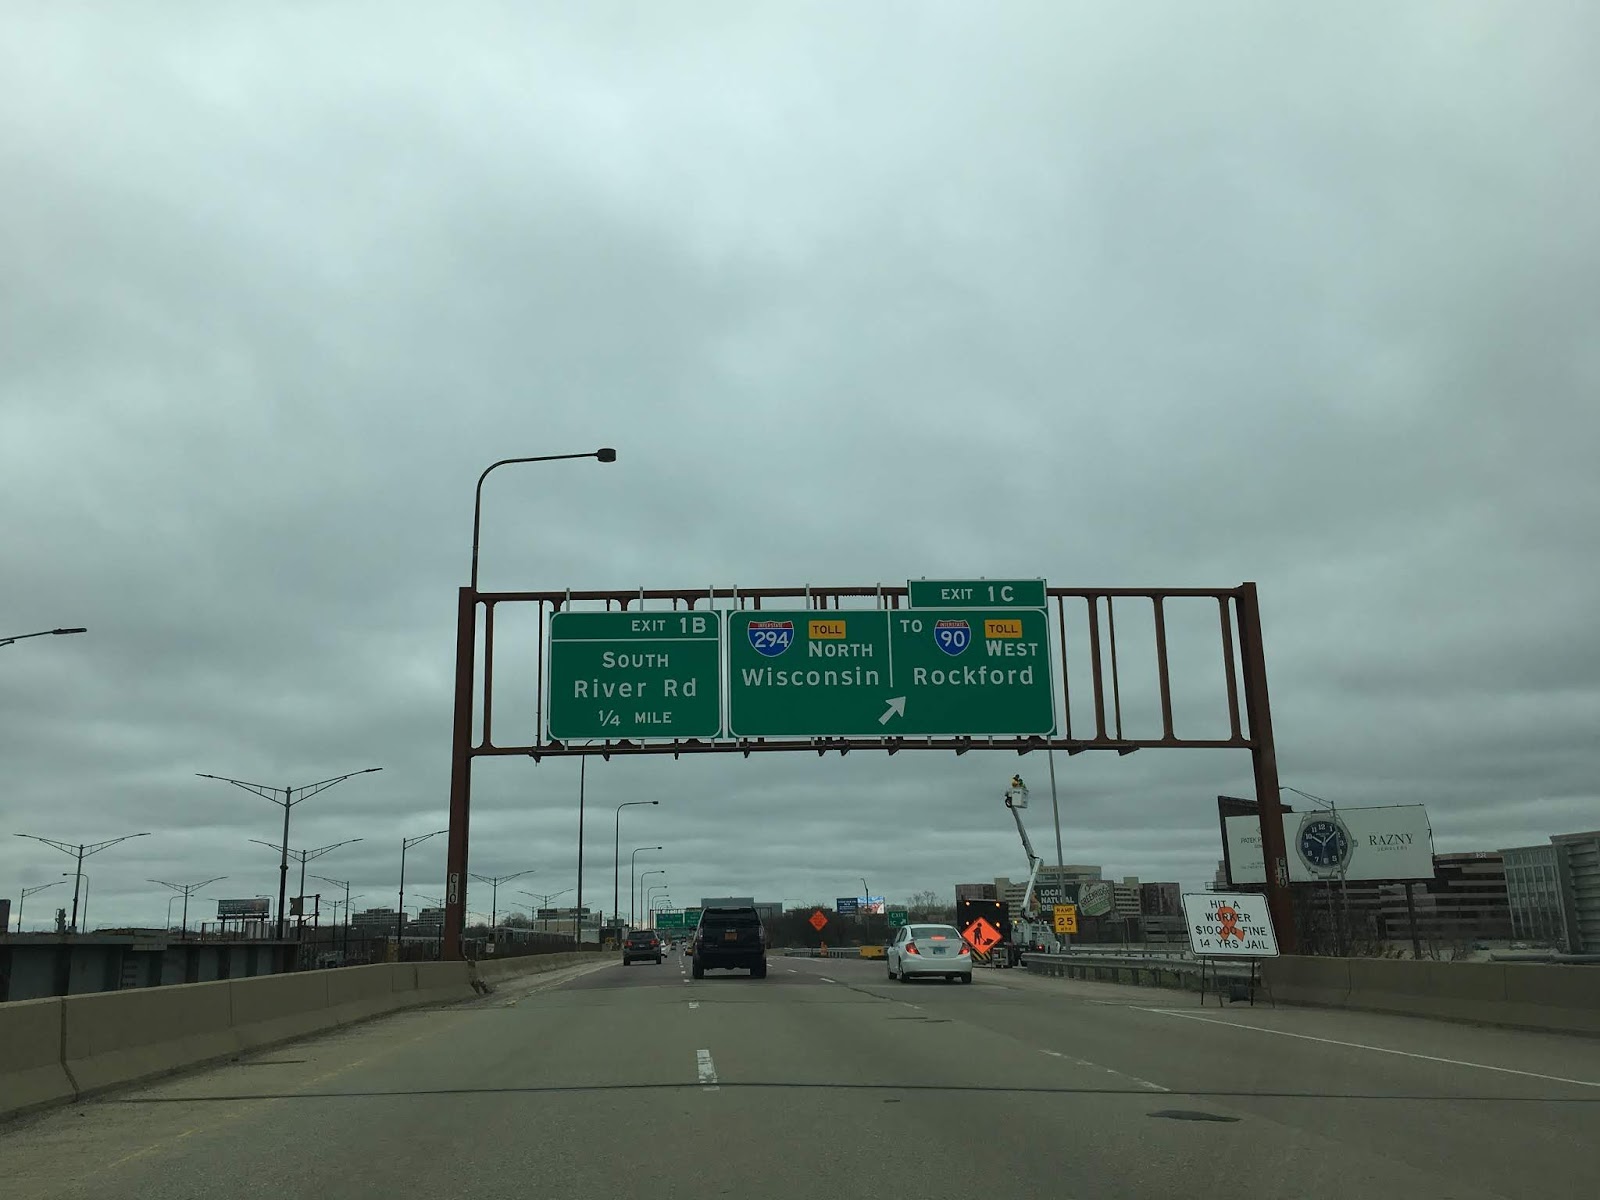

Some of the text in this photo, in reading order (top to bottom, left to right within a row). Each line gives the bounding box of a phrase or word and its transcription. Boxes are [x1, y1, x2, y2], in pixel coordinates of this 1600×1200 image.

[941, 586, 1014, 602] EXIT 1C
[632, 618, 706, 634] EXIT 1B
[812, 625, 842, 634] TOLL
[900, 620, 922, 632] TO
[989, 624, 1018, 633] TOLL
[754, 631, 788, 648] 294
[940, 631, 965, 647] 90
[808, 641, 873, 658] NORTH
[986, 640, 1038, 656] WEST
[602, 652, 669, 668] SOUTH
[742, 666, 879, 686] Wisconsin
[914, 666, 1033, 686] Rockford
[574, 678, 696, 698] River Rd
[634, 712, 672, 724] MILE
[1369, 833, 1413, 846] RAZNY
[1210, 900, 1240, 909] HIT A
[1205, 912, 1252, 922] WORKER
[1196, 926, 1268, 936] $10,000 FINE
[1200, 939, 1269, 950] 14 YRS JAIL
